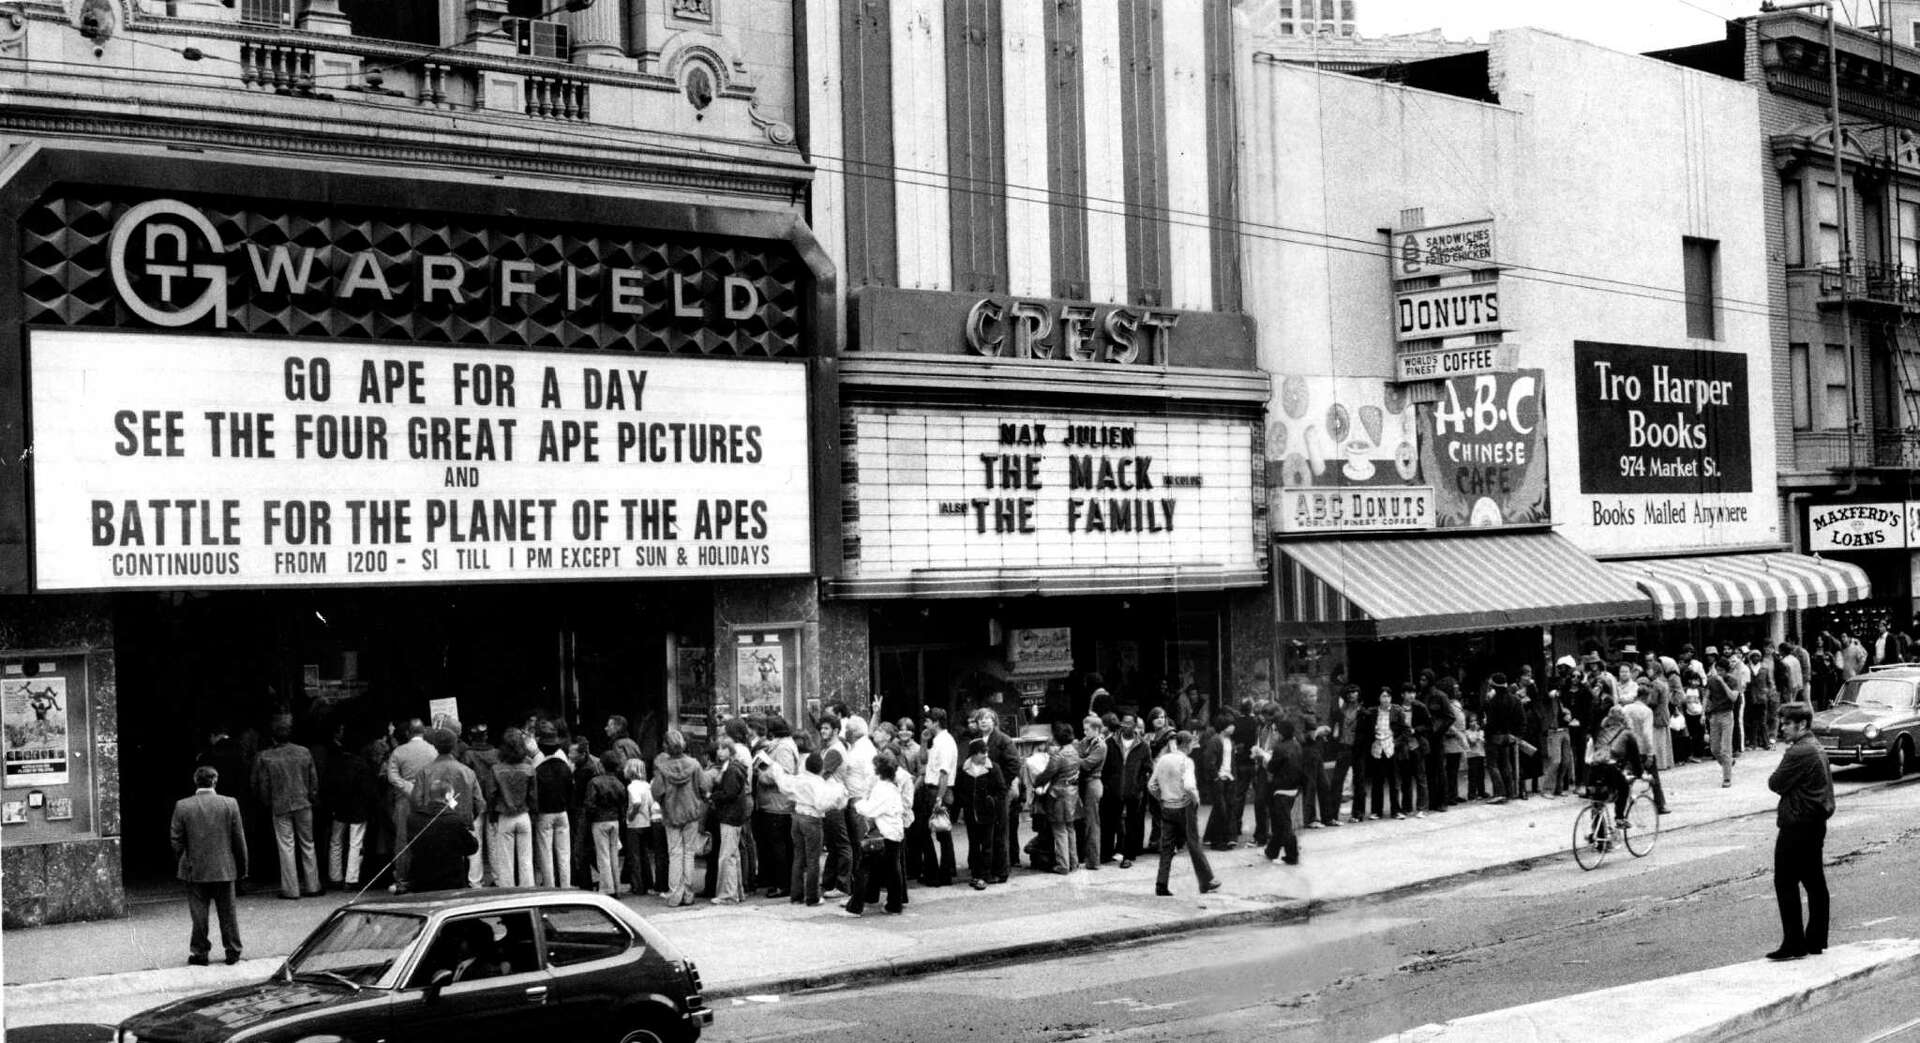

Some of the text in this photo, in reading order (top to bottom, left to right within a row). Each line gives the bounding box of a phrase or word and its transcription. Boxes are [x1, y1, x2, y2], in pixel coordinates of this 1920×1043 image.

[1426, 229, 1489, 248] SANDWICHES
[1425, 248, 1491, 266] FRIED CHICKEN
[244, 242, 760, 321] WARFIELD
[1400, 293, 1498, 332] DONUTS
[966, 299, 1180, 367] CREST
[1406, 365, 1437, 377] FINEST
[1443, 350, 1491, 372] COFFEE
[284, 356, 648, 411] GO APE FOR A DAY
[1593, 361, 1733, 415] Tro Harper
[114, 410, 762, 464] SEE THE FOUR GREAT APE PICTURES
[1063, 425, 1135, 448] JULIEN
[1628, 409, 1708, 449] Books
[1448, 441, 1525, 465] CHINESE
[1620, 455, 1722, 477] 974 Market St.
[444, 466, 479, 488] AND
[979, 453, 1043, 490] THE
[1068, 454, 1153, 490] MACK
[1456, 466, 1511, 495] CAFE
[971, 498, 1036, 534] THE
[1068, 497, 1177, 534] FAMILY
[1295, 493, 1425, 520] ABC DONUTS
[1592, 498, 1748, 529] Books Mailed Anywhere
[1812, 505, 1901, 532] MAXFERD'S
[91, 498, 768, 547] BATTLE FOR THE PLANET OF THE APES
[1344, 518, 1377, 526] FINEST
[1382, 517, 1418, 526] COFFEE
[1830, 529, 1886, 547] LOANS
[112, 552, 240, 576] CONTINUOUS
[275, 551, 326, 574] FROM
[456, 548, 490, 570] TILL
[527, 547, 552, 568] PM
[561, 546, 621, 568] EXCEPT
[636, 545, 667, 567] SUN
[676, 546, 688, 566] &
[698, 544, 769, 566] HOLIDAYS
